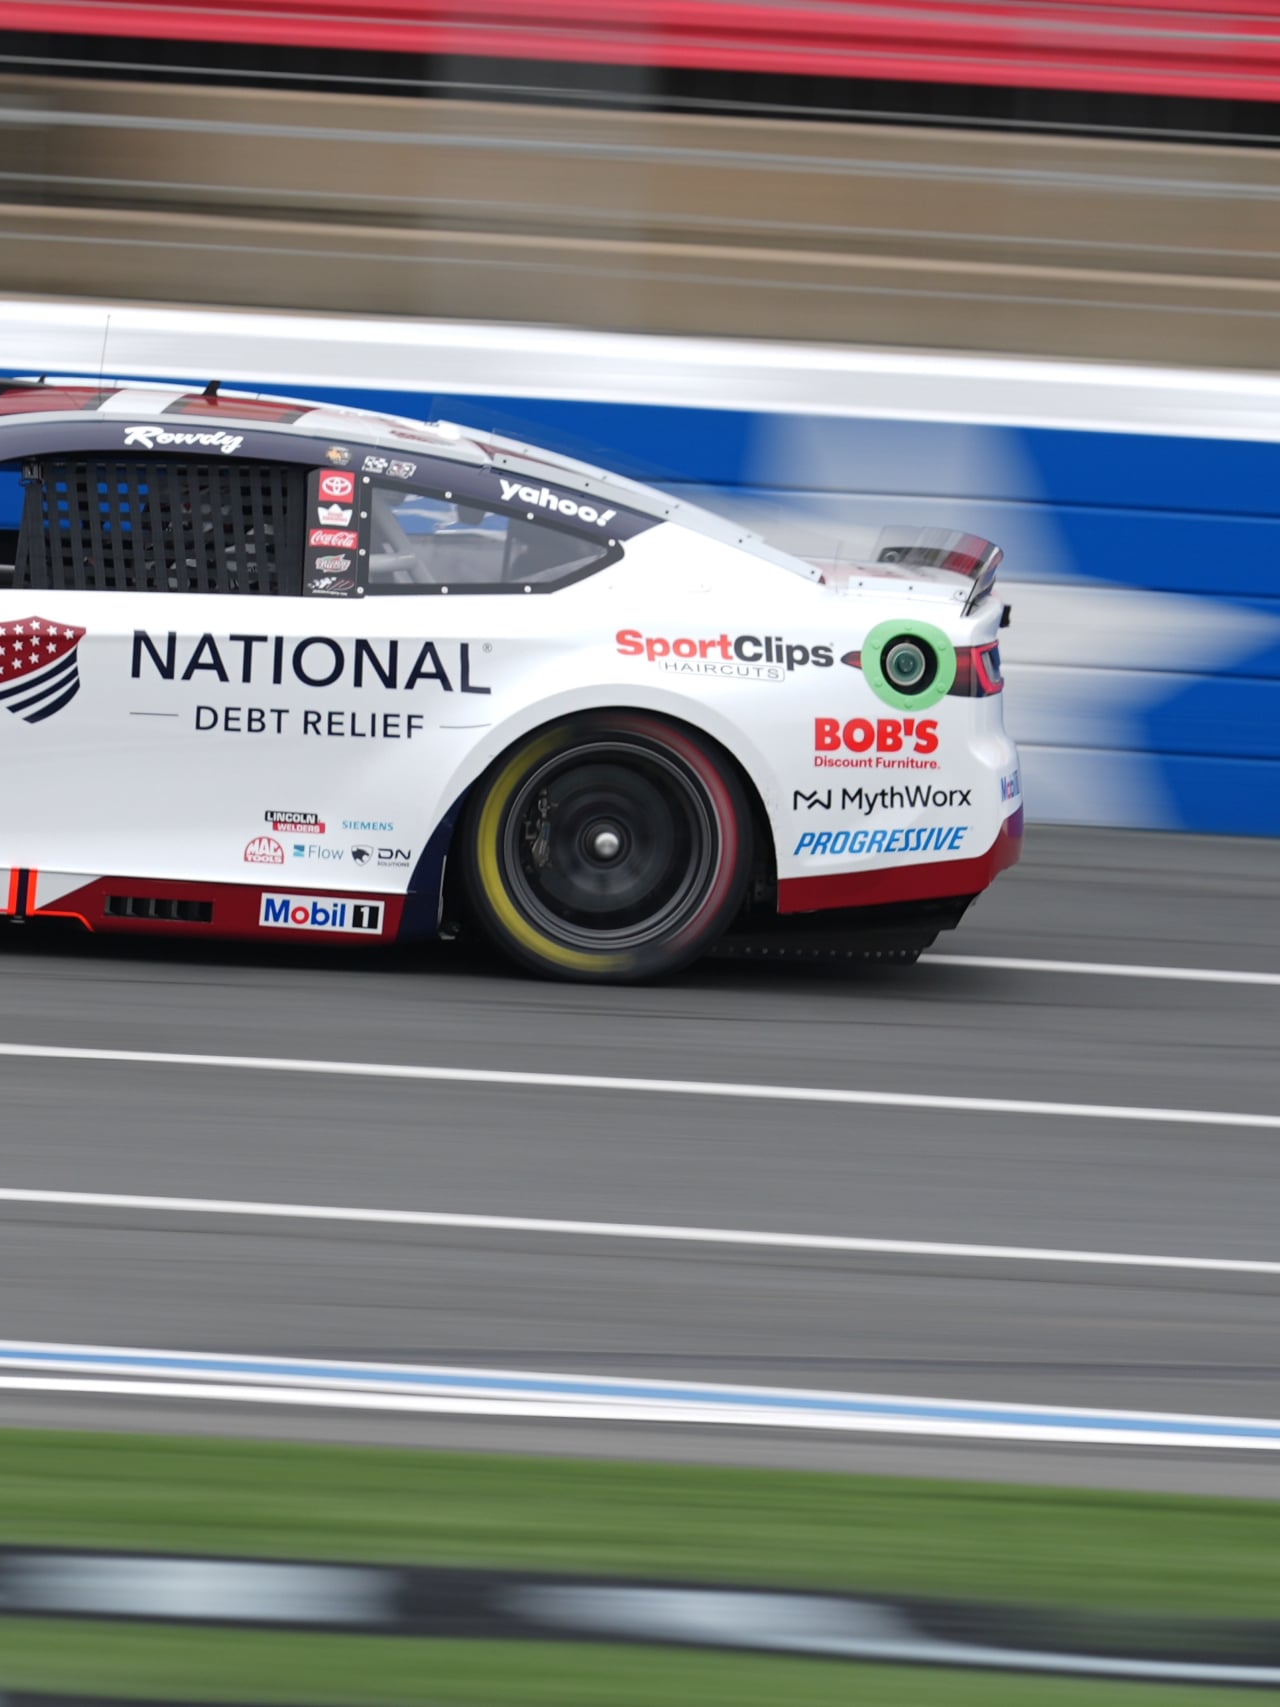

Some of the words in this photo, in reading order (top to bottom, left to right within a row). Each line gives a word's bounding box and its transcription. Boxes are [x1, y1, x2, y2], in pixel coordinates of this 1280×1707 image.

[124, 425, 244, 454] Rowdy
[499, 478, 617, 527] yahoo!
[131, 630, 492, 695] NATIONAL
[664, 661, 780, 679] HAIRCUTS
[195, 705, 290, 735] DEBT
[303, 710, 425, 739] RELIEF
[815, 718, 939, 754] BOB'S
[814, 755, 873, 768] Discount
[841, 785, 972, 816] MythWorx
[267, 812, 316, 824] LINCOLN
[342, 820, 394, 831] SIEMENS
[276, 823, 320, 833] WELDERS
[248, 838, 280, 854] MAC
[793, 826, 969, 856] PROGRESSIVE
[247, 855, 283, 863] TOOLS
[308, 845, 344, 860] Flow
[377, 848, 412, 860] DN
[264, 898, 346, 927] Mobil
